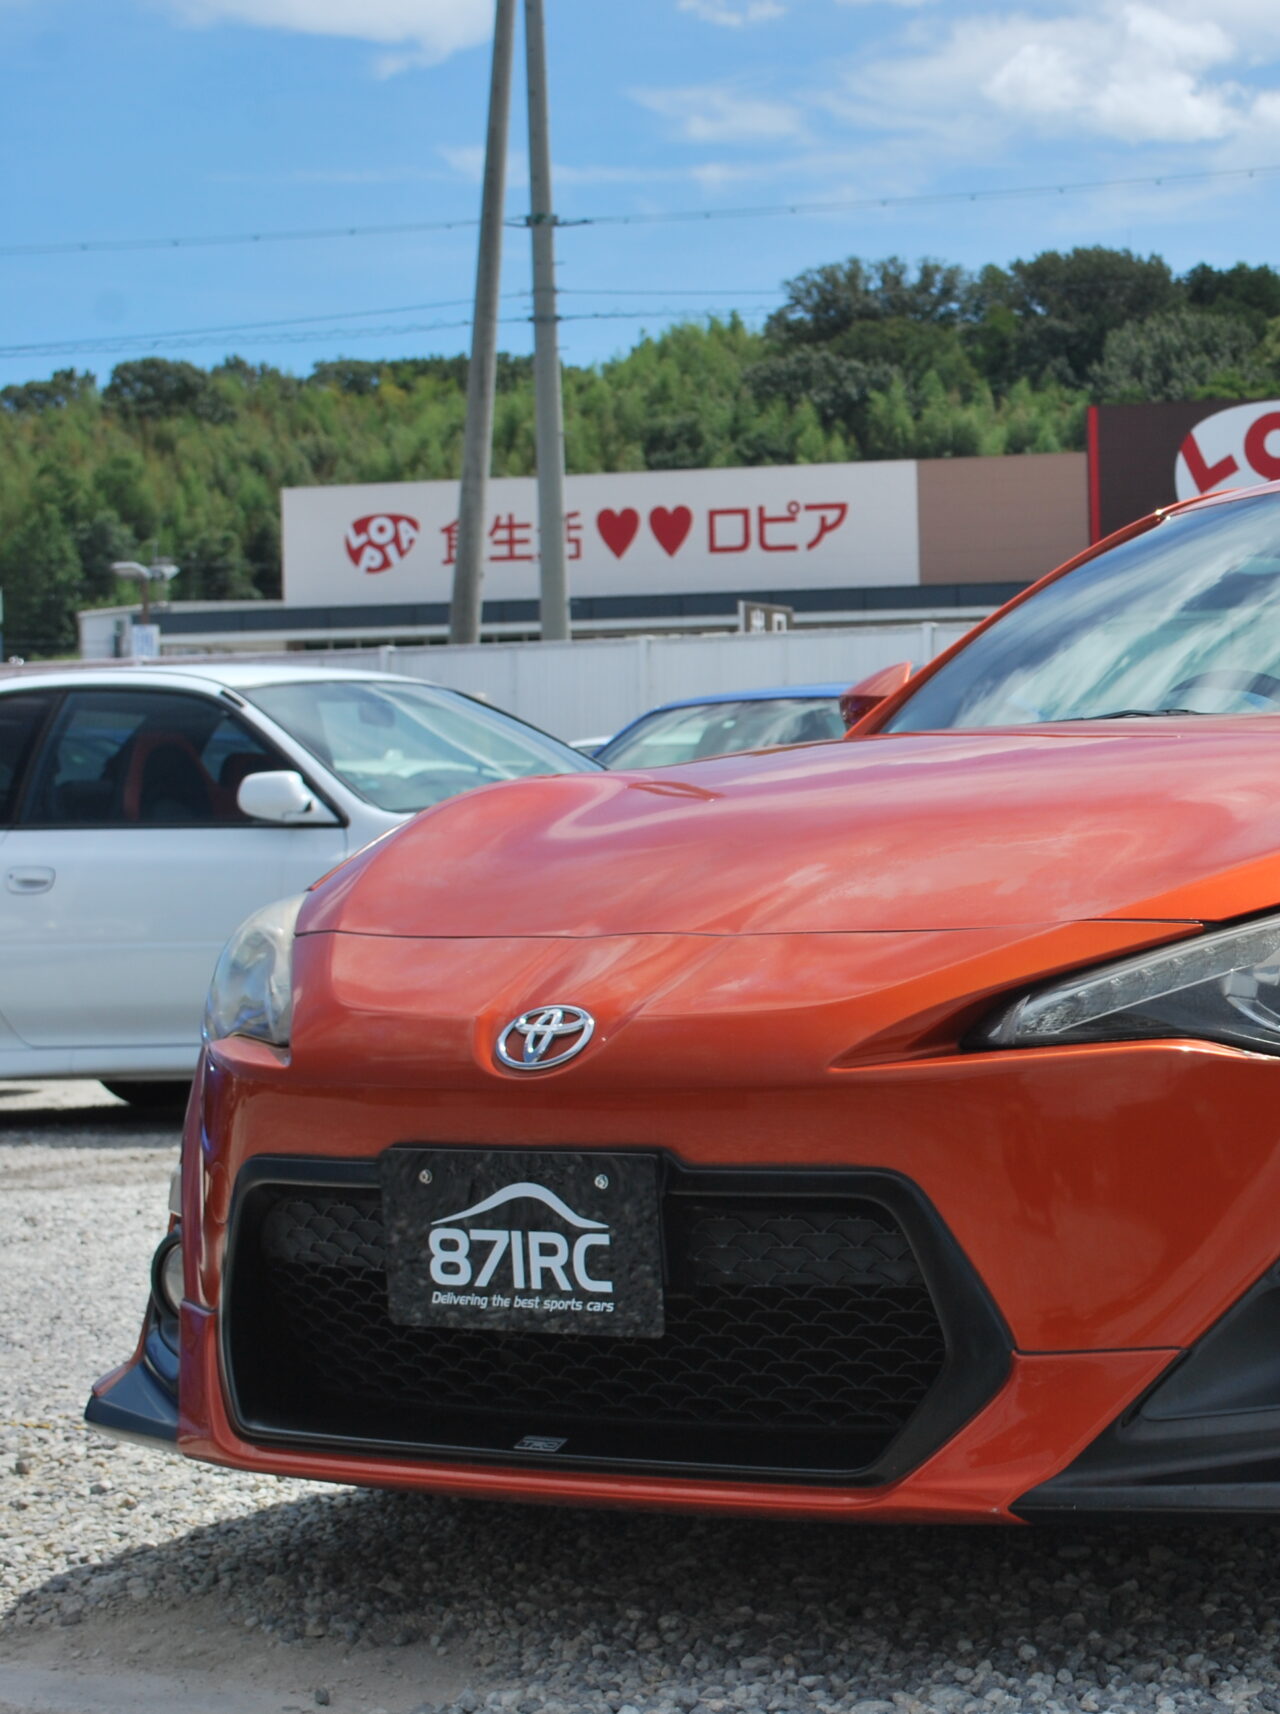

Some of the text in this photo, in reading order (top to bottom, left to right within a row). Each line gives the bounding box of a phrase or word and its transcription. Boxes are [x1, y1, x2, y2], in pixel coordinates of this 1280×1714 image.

[708, 500, 848, 553] ロピア
[431, 1291, 615, 1312] Delivering the best sports cars
